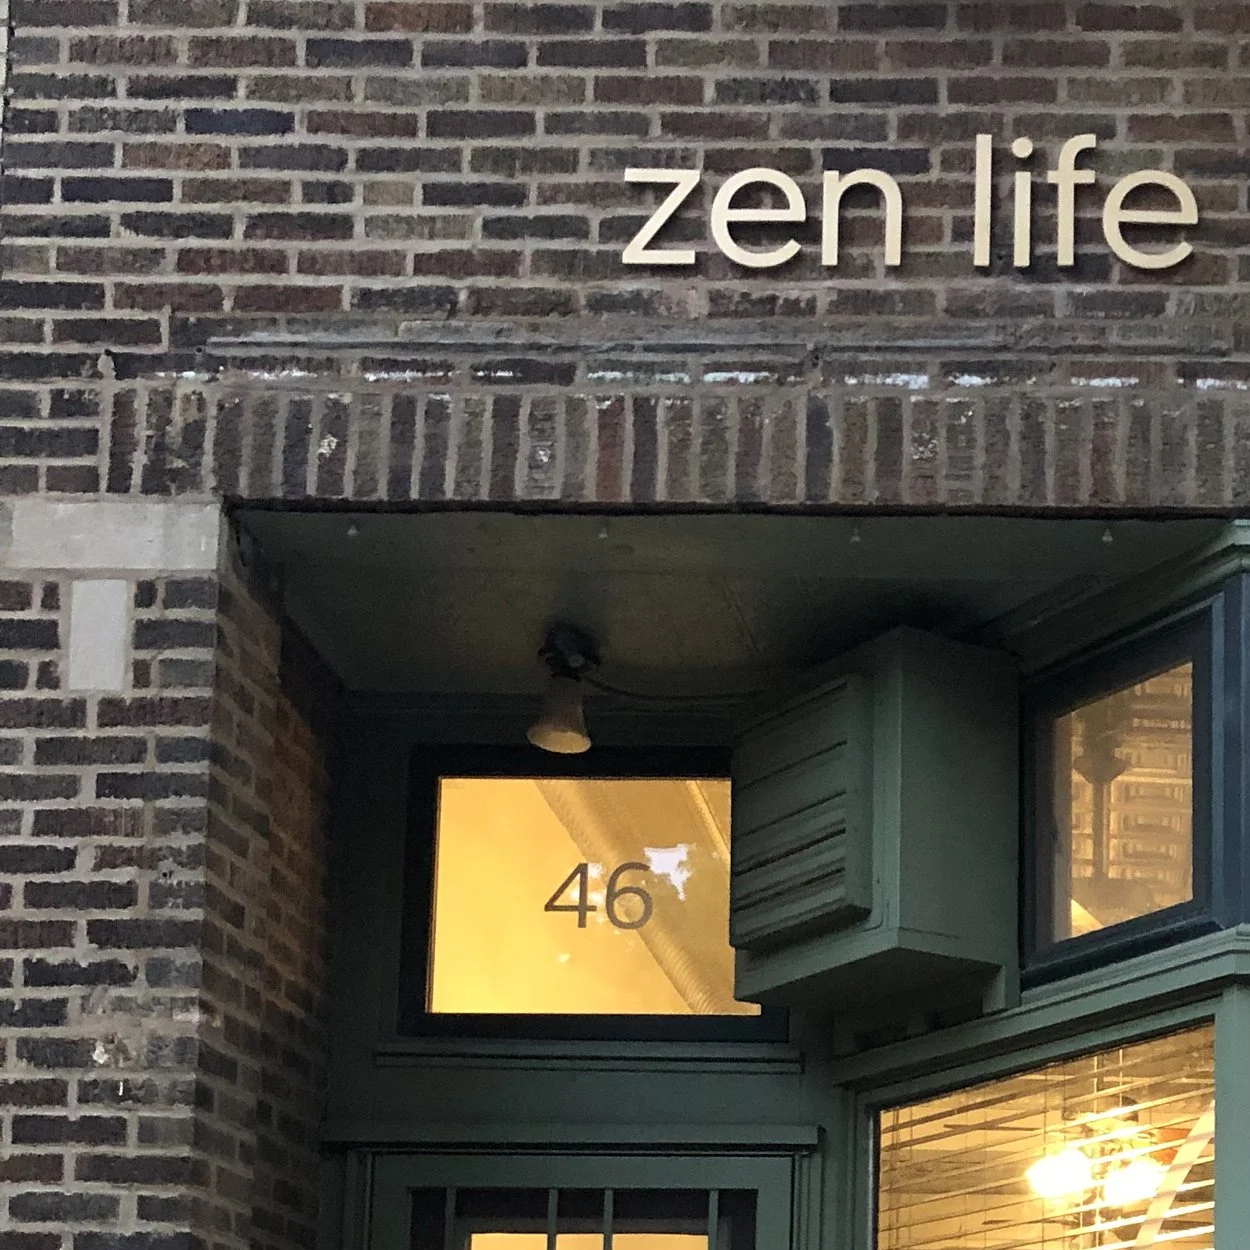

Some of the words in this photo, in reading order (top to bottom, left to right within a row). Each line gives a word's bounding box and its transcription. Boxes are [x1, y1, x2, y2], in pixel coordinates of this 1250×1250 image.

[621, 167, 903, 267] zen
[974, 133, 1199, 269] life
[544, 862, 654, 930] 46
